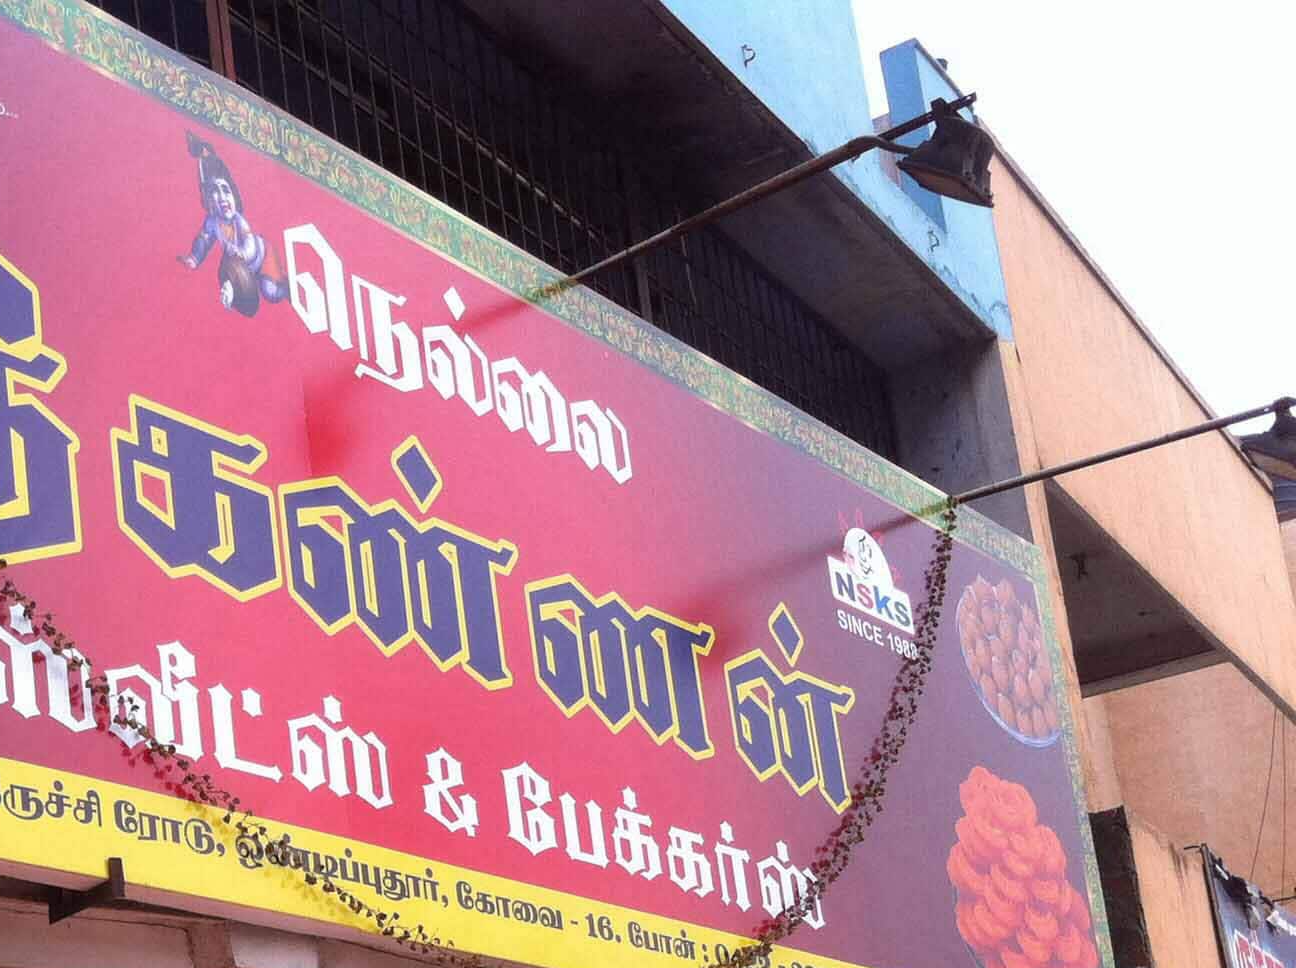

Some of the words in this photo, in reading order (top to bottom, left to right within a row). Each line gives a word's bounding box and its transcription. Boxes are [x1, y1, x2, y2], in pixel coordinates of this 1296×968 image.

[283, 223, 634, 485] நெல்லை
[109, 393, 855, 813] கண்ணன்
[837, 609, 885, 647] SINCE
[115, 799, 226, 857] ரோடு,
[456, 880, 564, 931] கோவை
[422, 746, 480, 837] &
[501, 761, 826, 930] பேக்கர்ஸ்
